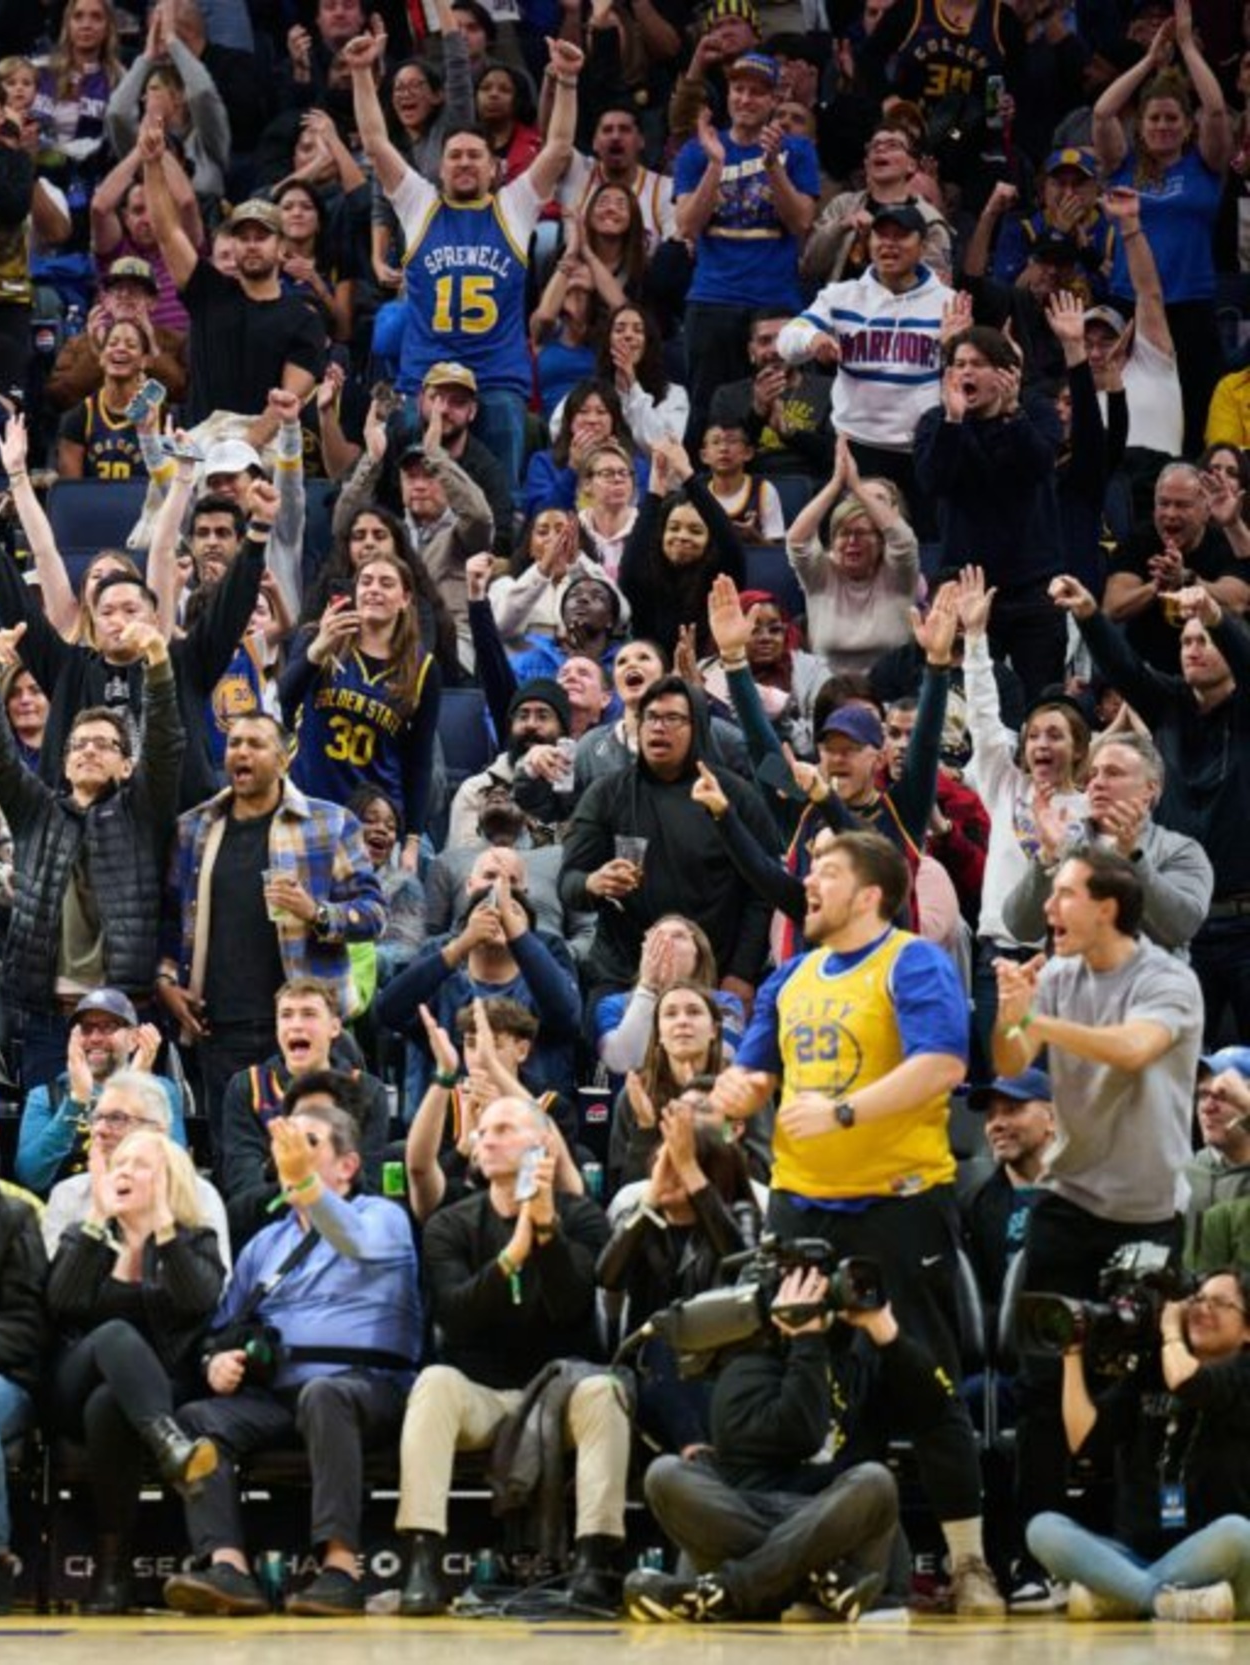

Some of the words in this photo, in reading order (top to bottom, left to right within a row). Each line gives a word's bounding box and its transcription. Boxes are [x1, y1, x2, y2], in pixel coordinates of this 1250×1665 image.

[424, 245, 512, 278] SPREWELL
[432, 274, 498, 333] 15
[325, 714, 376, 766] 30
[794, 1023, 839, 1064] 23
